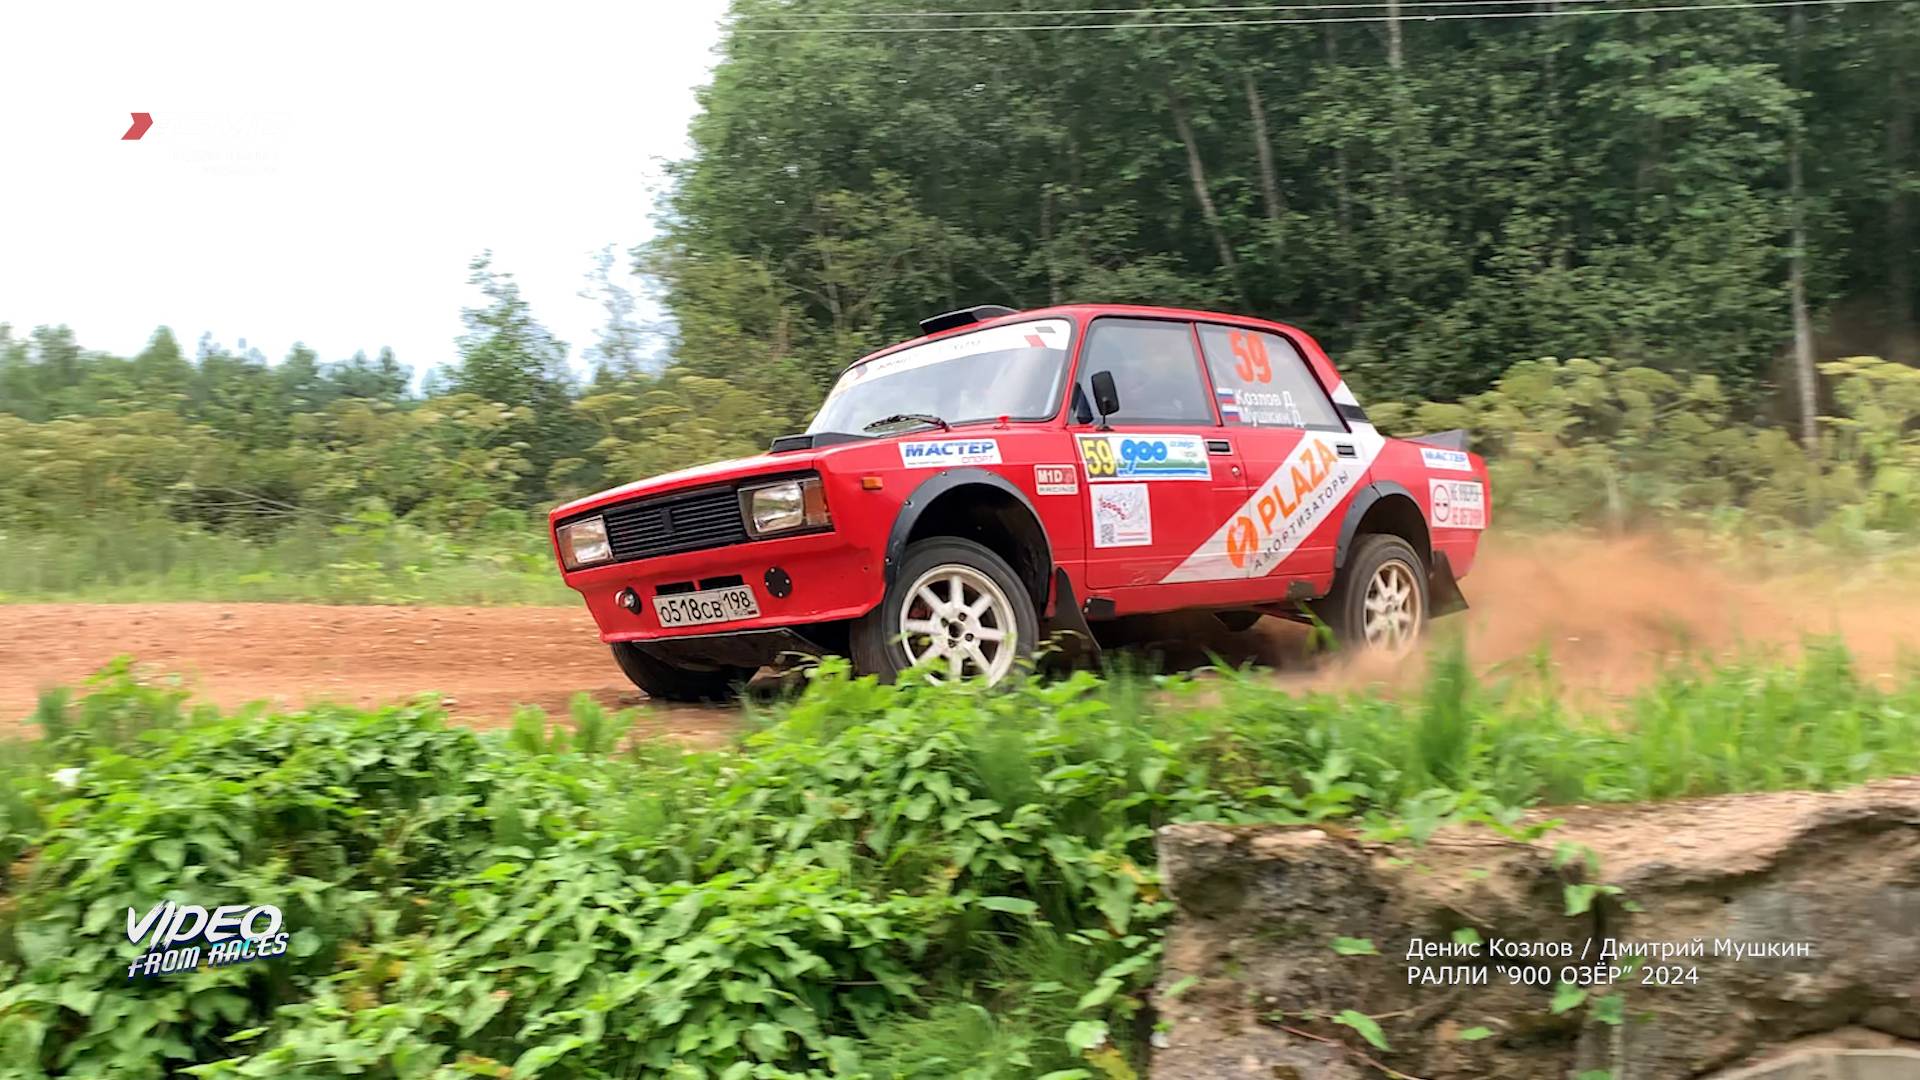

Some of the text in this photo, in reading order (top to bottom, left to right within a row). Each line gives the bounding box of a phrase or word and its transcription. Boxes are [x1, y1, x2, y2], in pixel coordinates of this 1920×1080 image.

[1230, 332, 1272, 383] 59
[1234, 389, 1282, 406] Козлов
[905, 441, 994, 457] МАСТЕР
[1082, 440, 1116, 476] 59
[1120, 439, 1168, 474] 900
[1257, 438, 1340, 536] PLAZA
[1253, 470, 1349, 570] АМОРТИЗАТОРЫ
[723, 591, 751, 610] 198
